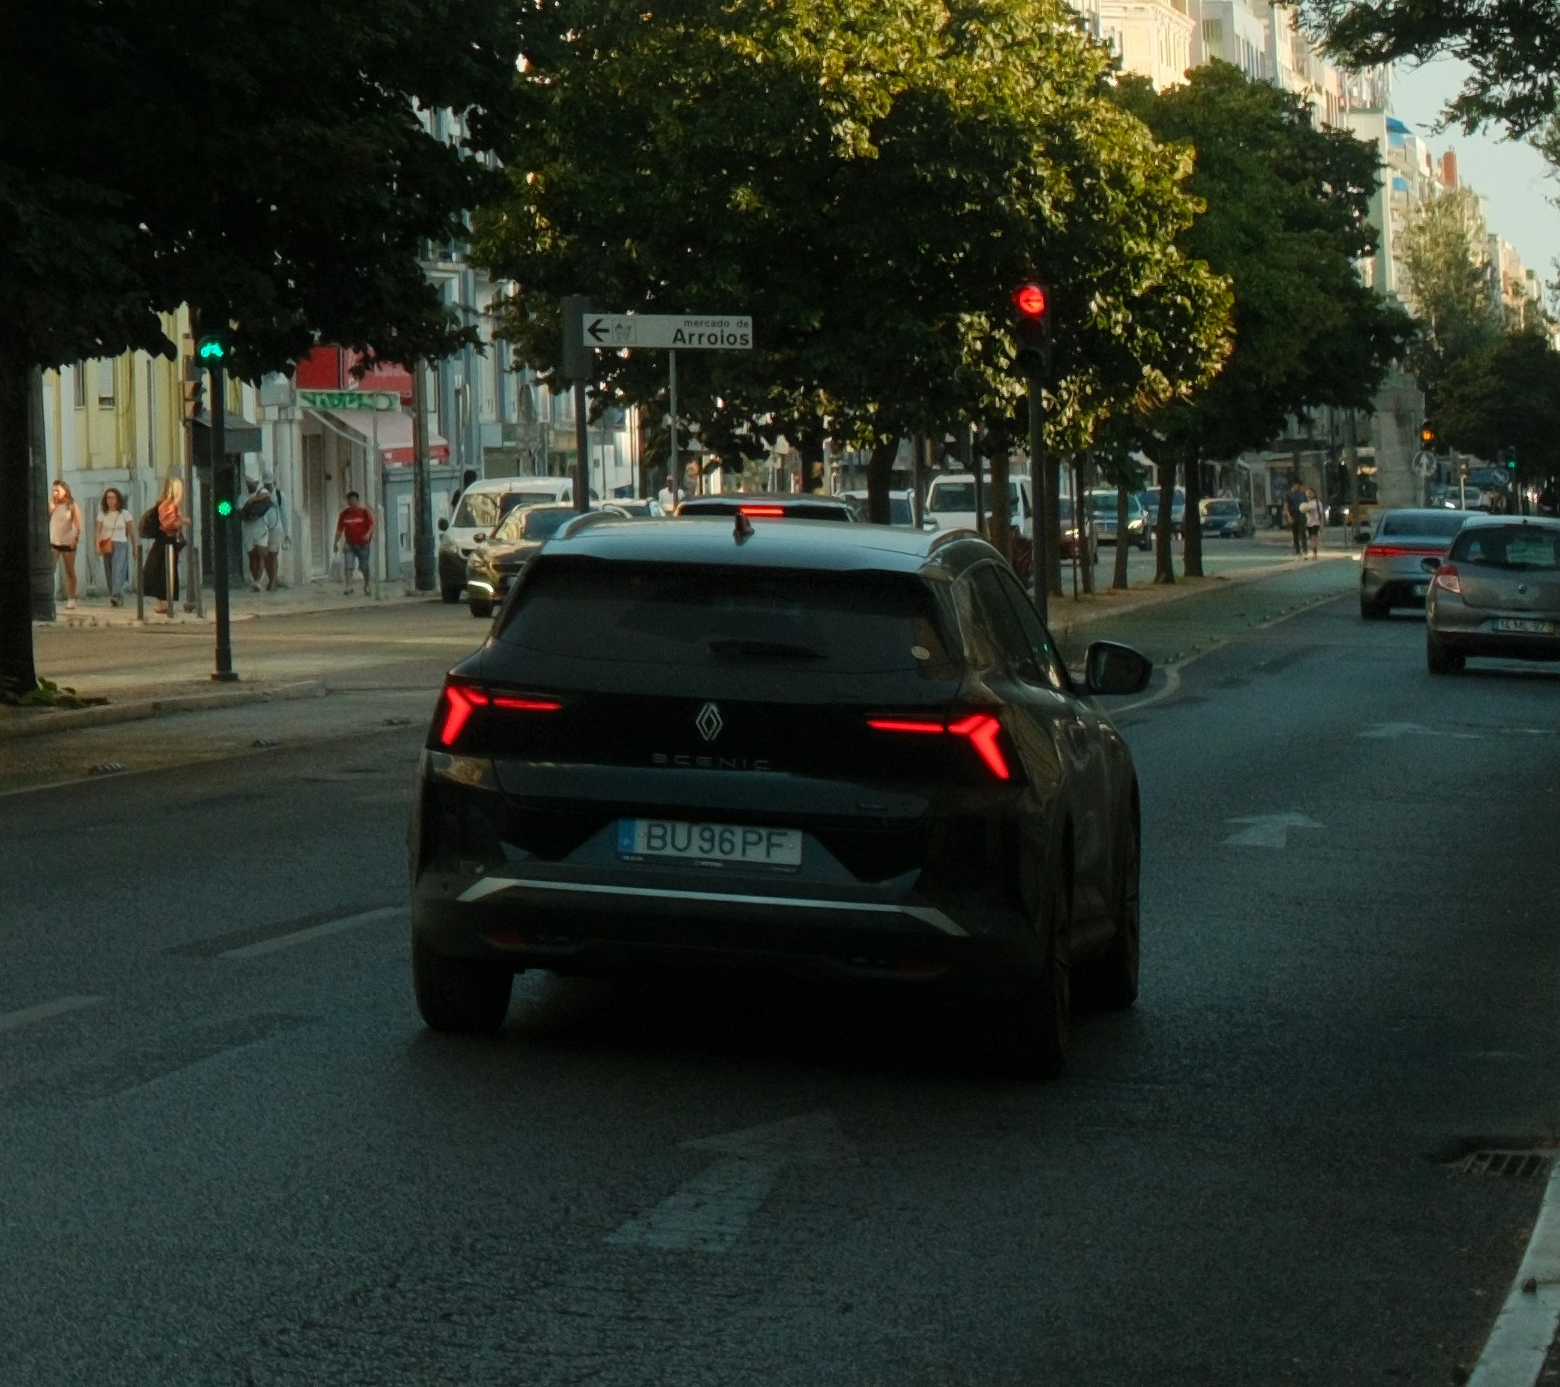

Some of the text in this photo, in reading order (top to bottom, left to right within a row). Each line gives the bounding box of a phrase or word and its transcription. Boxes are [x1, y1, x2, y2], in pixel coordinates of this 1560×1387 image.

[684, 320, 749, 328] mercado de
[672, 328, 750, 346] Arroios
[651, 753, 771, 771] SCENIC
